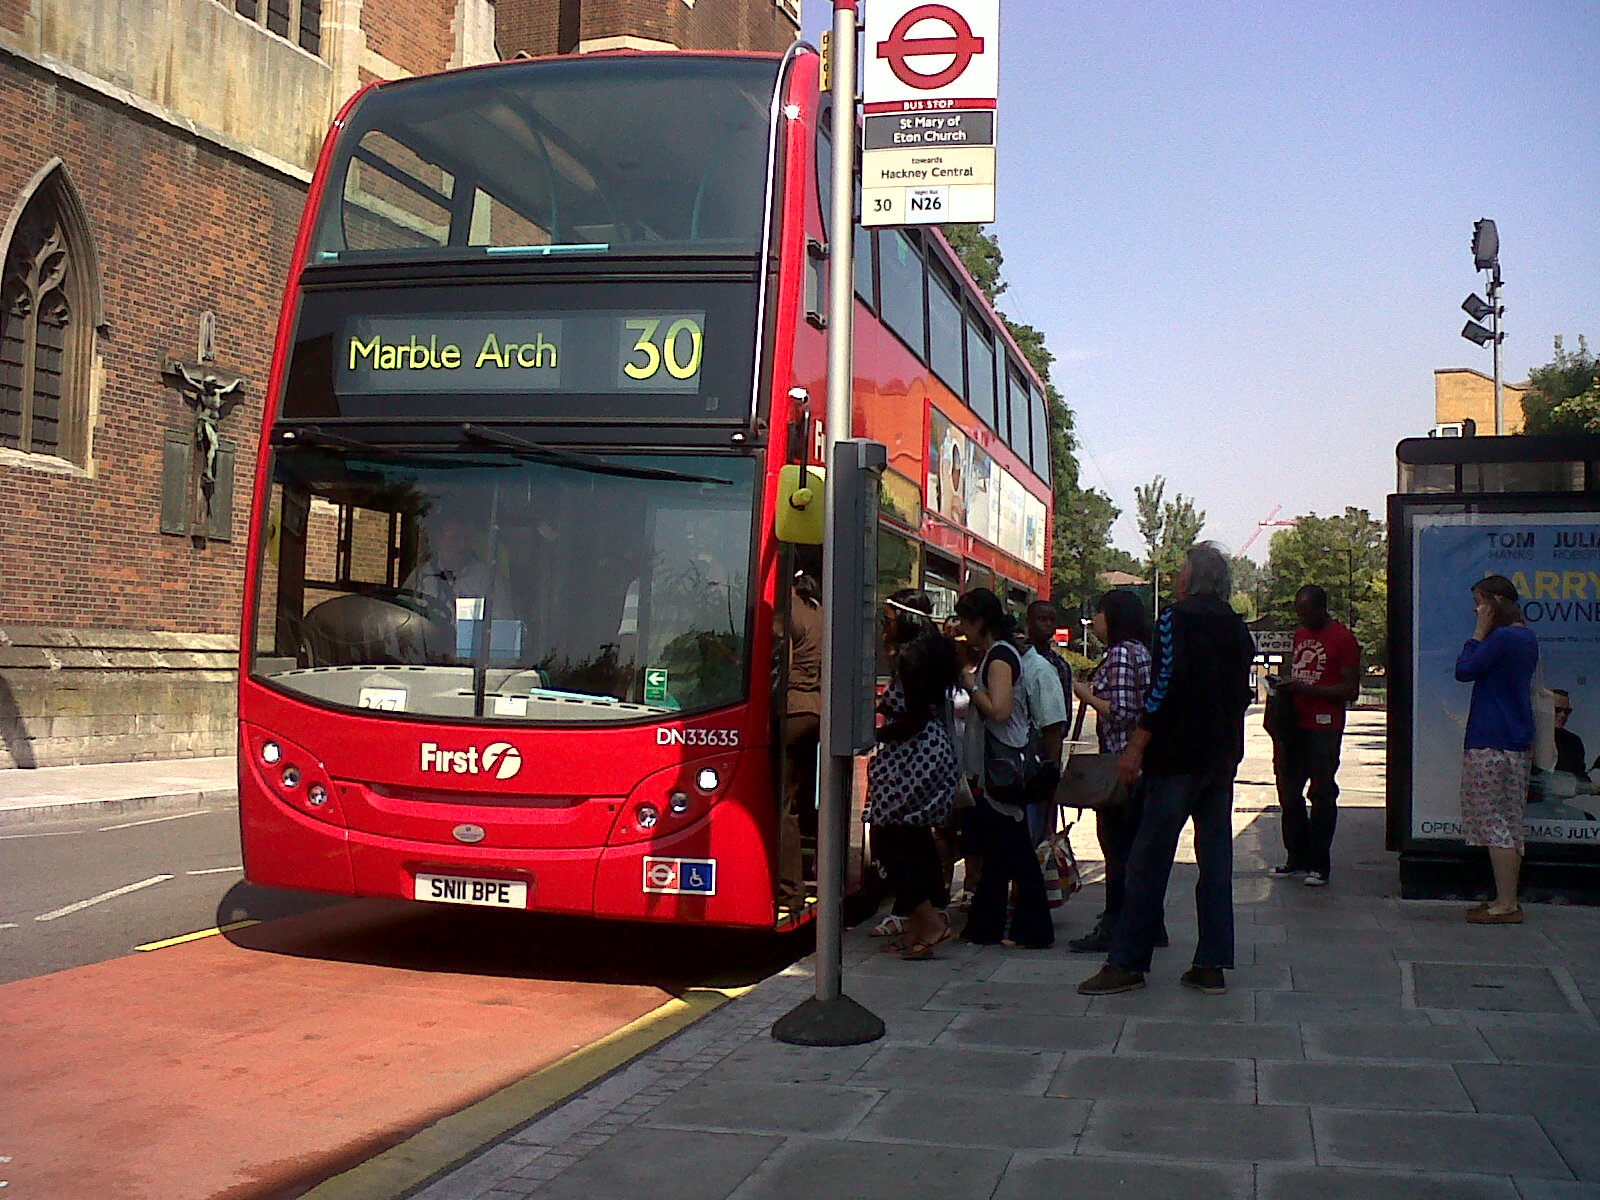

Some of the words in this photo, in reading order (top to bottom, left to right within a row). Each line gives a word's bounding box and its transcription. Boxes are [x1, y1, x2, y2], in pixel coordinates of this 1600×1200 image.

[903, 101, 924, 110] BUS
[927, 99, 954, 109] STOP
[899, 118, 912, 129] St
[914, 116, 944, 129] Mary
[947, 115, 961, 127] of
[893, 132, 921, 143] Eton
[924, 130, 967, 141] Church
[881, 168, 928, 180] Hackney
[931, 167, 973, 177] Central
[873, 199, 892, 212] 30
[911, 197, 942, 211] N26
[349, 334, 461, 370] Marble
[475, 332, 557, 368] Arch
[623, 318, 703, 380] 30
[1486, 531, 1535, 549] TOM
[1553, 531, 1600, 548] JULI
[1488, 549, 1535, 560] HANKS
[656, 727, 739, 746] DN33635
[421, 742, 479, 774] First
[1567, 827, 1600, 839] JULY
[431, 878, 467, 900] SN11
[472, 881, 511, 903] BPE
